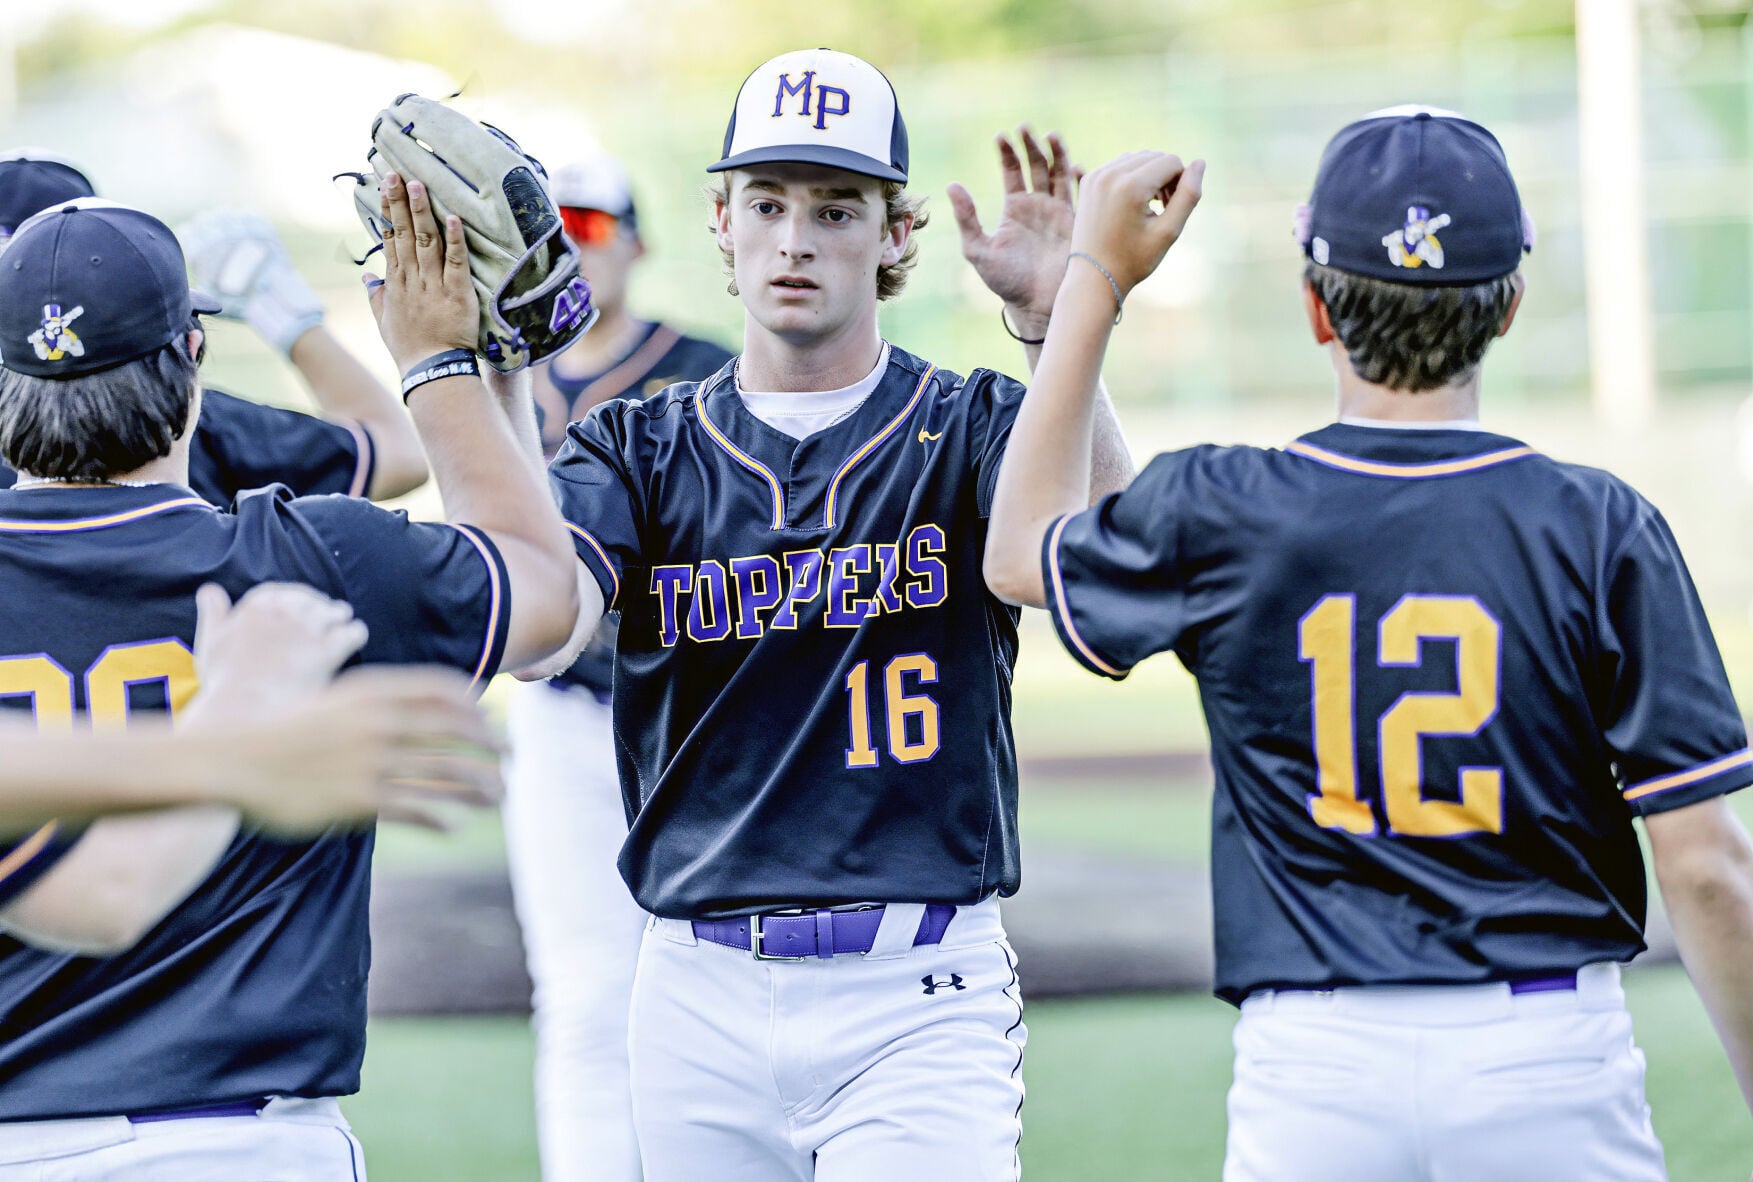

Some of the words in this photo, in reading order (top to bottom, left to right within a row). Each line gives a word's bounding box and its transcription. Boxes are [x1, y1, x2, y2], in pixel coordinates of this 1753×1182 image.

[771, 70, 850, 130] MP
[650, 523, 948, 647] TOPPERS
[845, 651, 941, 769] 16
[1297, 592, 1504, 838] 12
